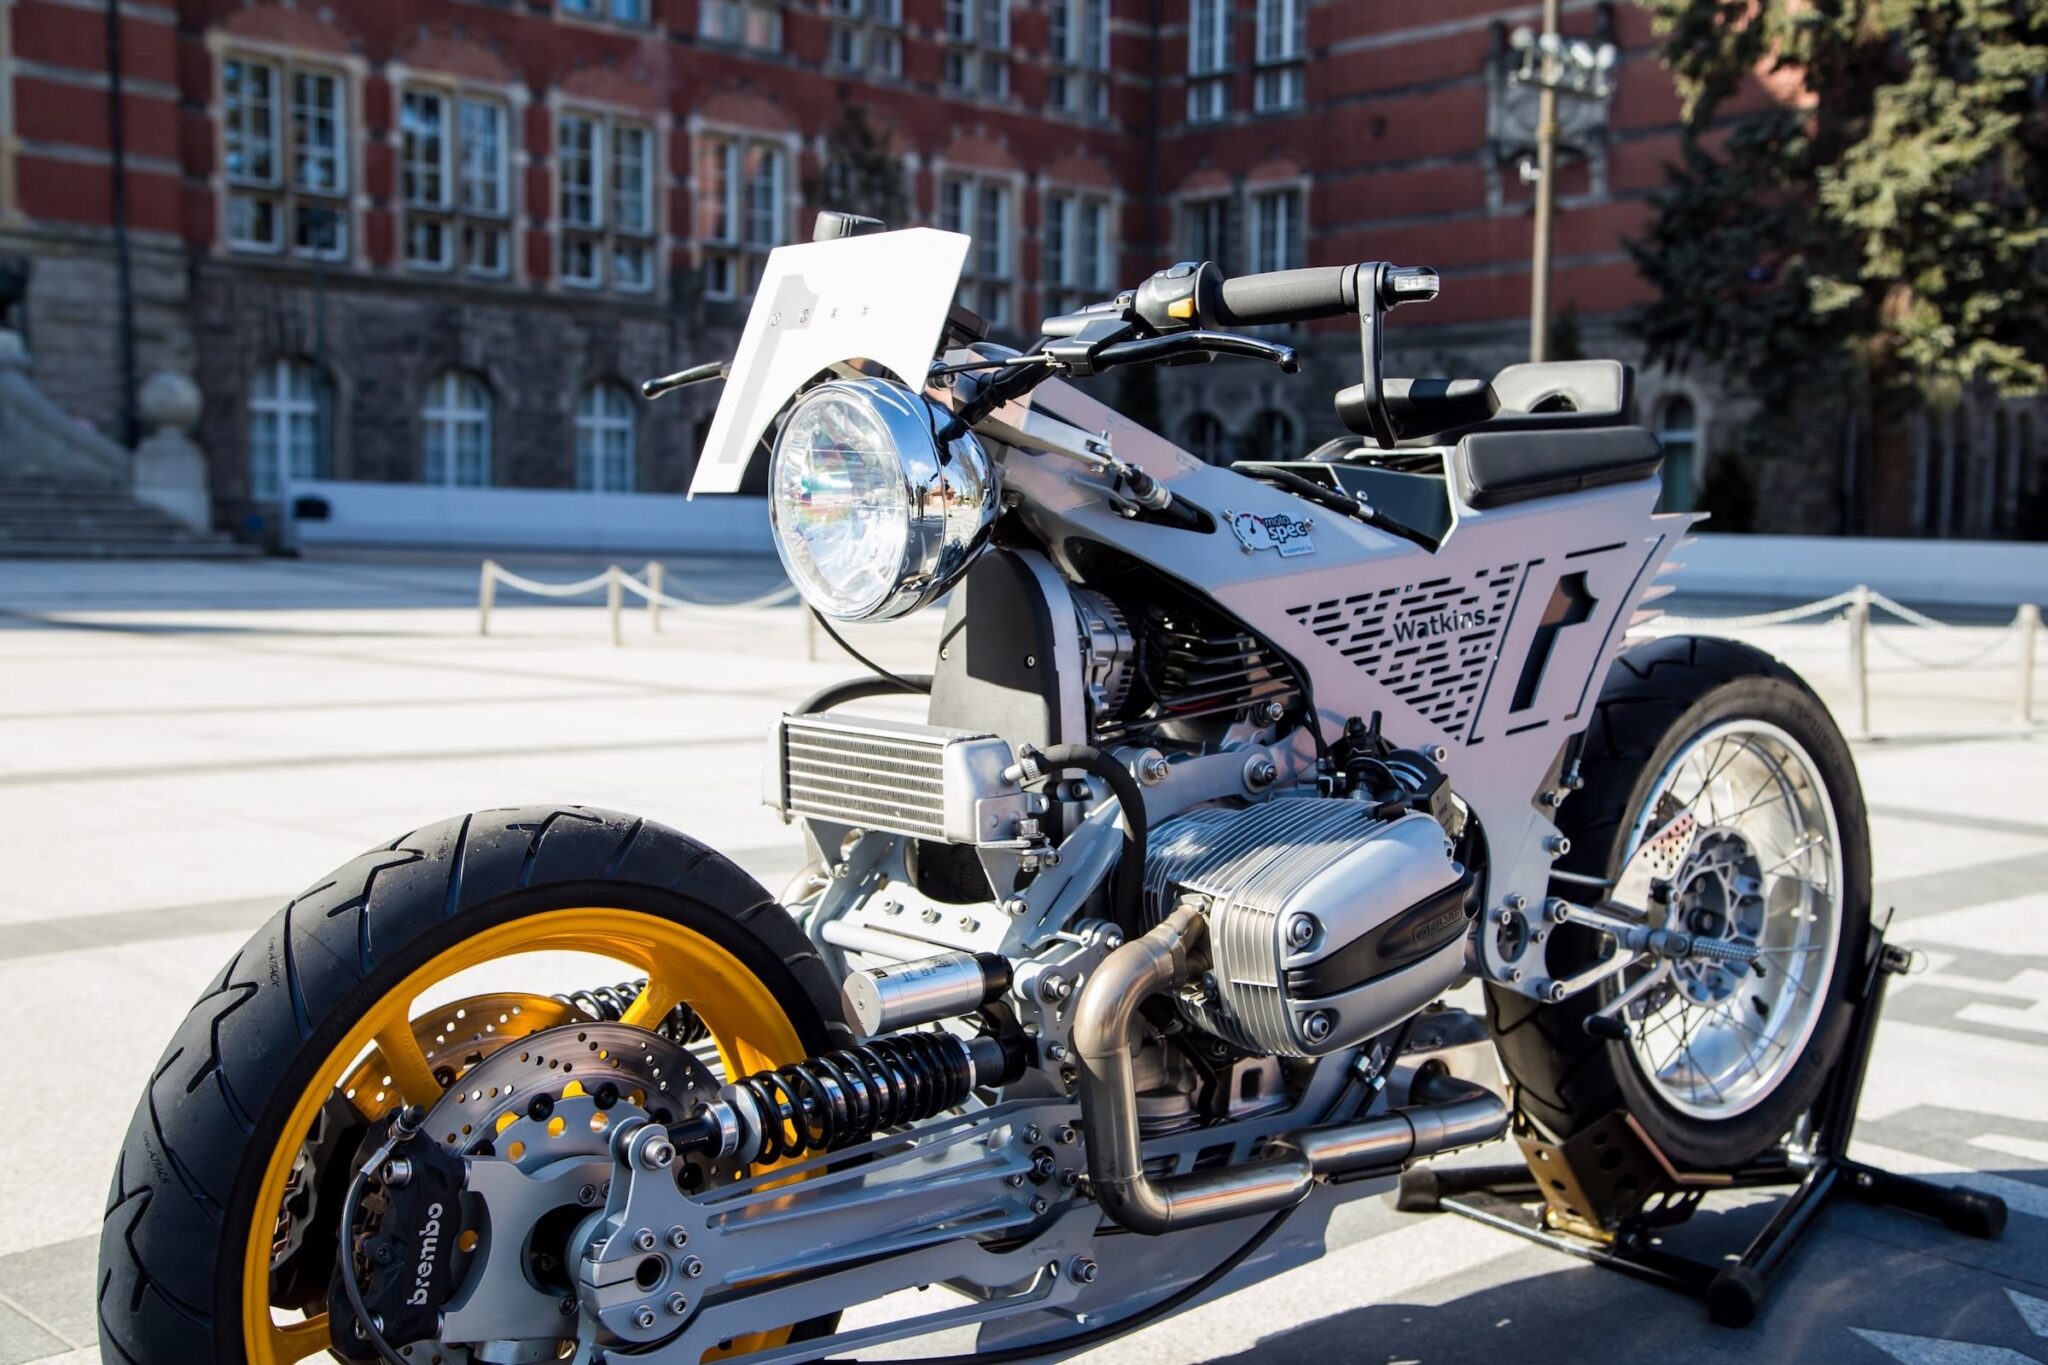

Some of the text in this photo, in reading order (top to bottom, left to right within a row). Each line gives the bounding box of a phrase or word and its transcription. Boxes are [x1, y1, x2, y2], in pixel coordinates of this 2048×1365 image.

[1264, 515, 1290, 527] moto
[1268, 522, 1306, 543] spec
[1393, 609, 1486, 643] Watkins
[406, 1202, 444, 1305] brembo
